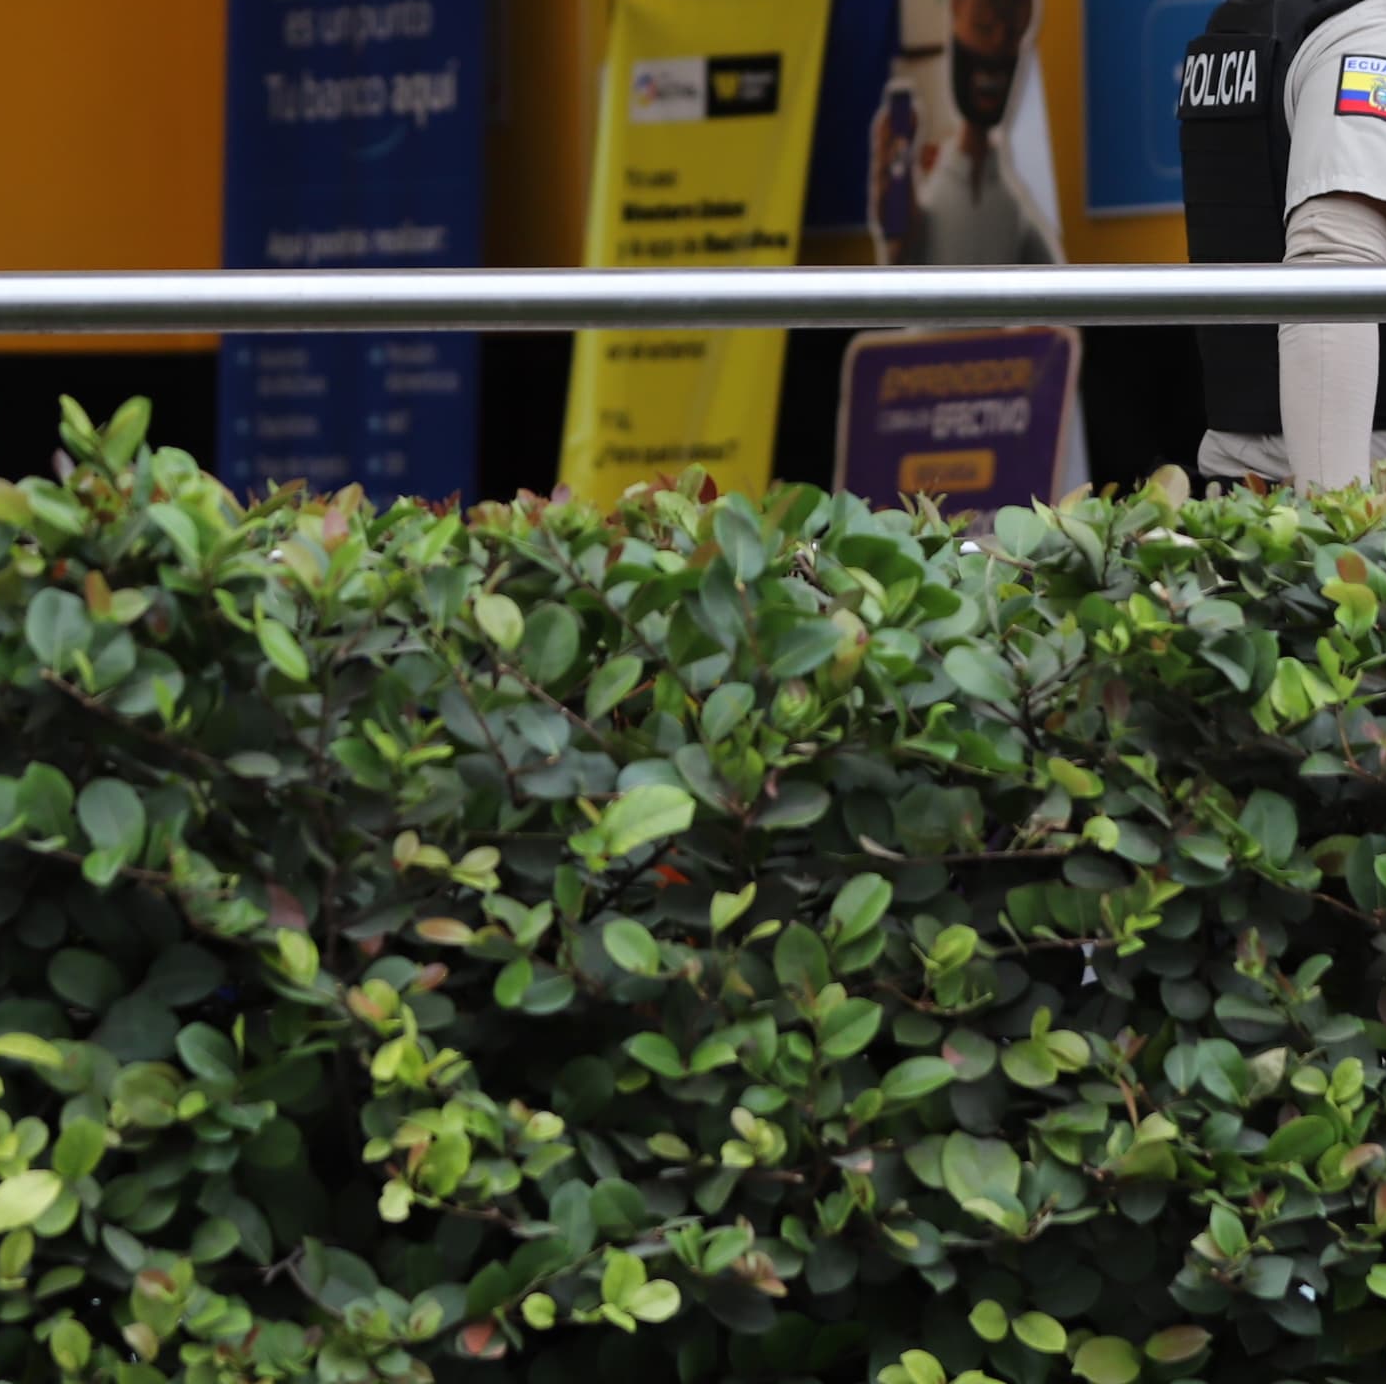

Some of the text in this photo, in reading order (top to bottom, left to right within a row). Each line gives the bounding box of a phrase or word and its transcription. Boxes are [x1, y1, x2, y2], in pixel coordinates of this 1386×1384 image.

[301, 70, 386, 121] banco
[392, 59, 459, 126] aquí
[1179, 49, 1258, 108] POLICIA
